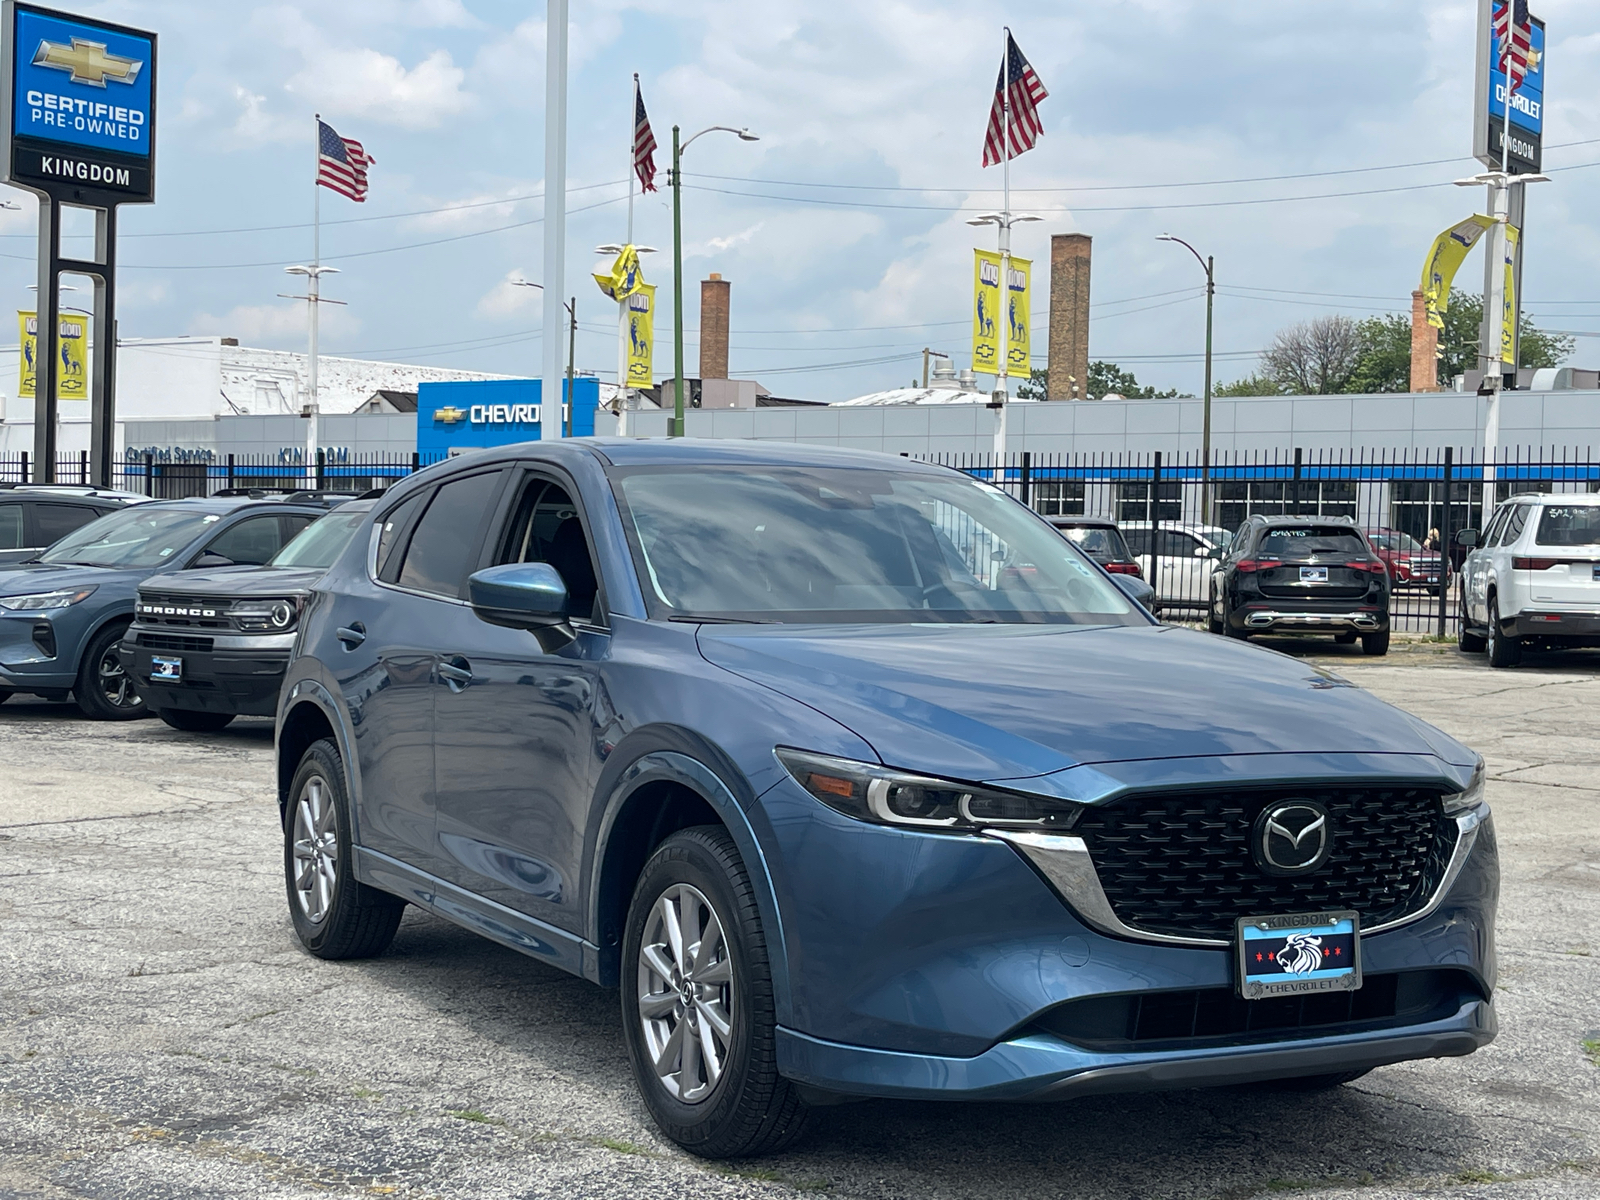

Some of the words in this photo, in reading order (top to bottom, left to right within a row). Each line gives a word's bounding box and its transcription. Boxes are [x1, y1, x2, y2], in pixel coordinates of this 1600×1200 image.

[27, 90, 144, 125] CERTIFIED
[32, 108, 139, 140] PRE-OWNED
[1500, 132, 1534, 160] KNGDOM
[42, 156, 130, 186] KINGDOM
[470, 404, 568, 423] CHEVROT
[280, 447, 348, 463] KINDOM
[143, 606, 215, 616] BRONCO
[1268, 914, 1330, 928] KINGDOM
[1270, 980, 1332, 994] CHEVROLET
